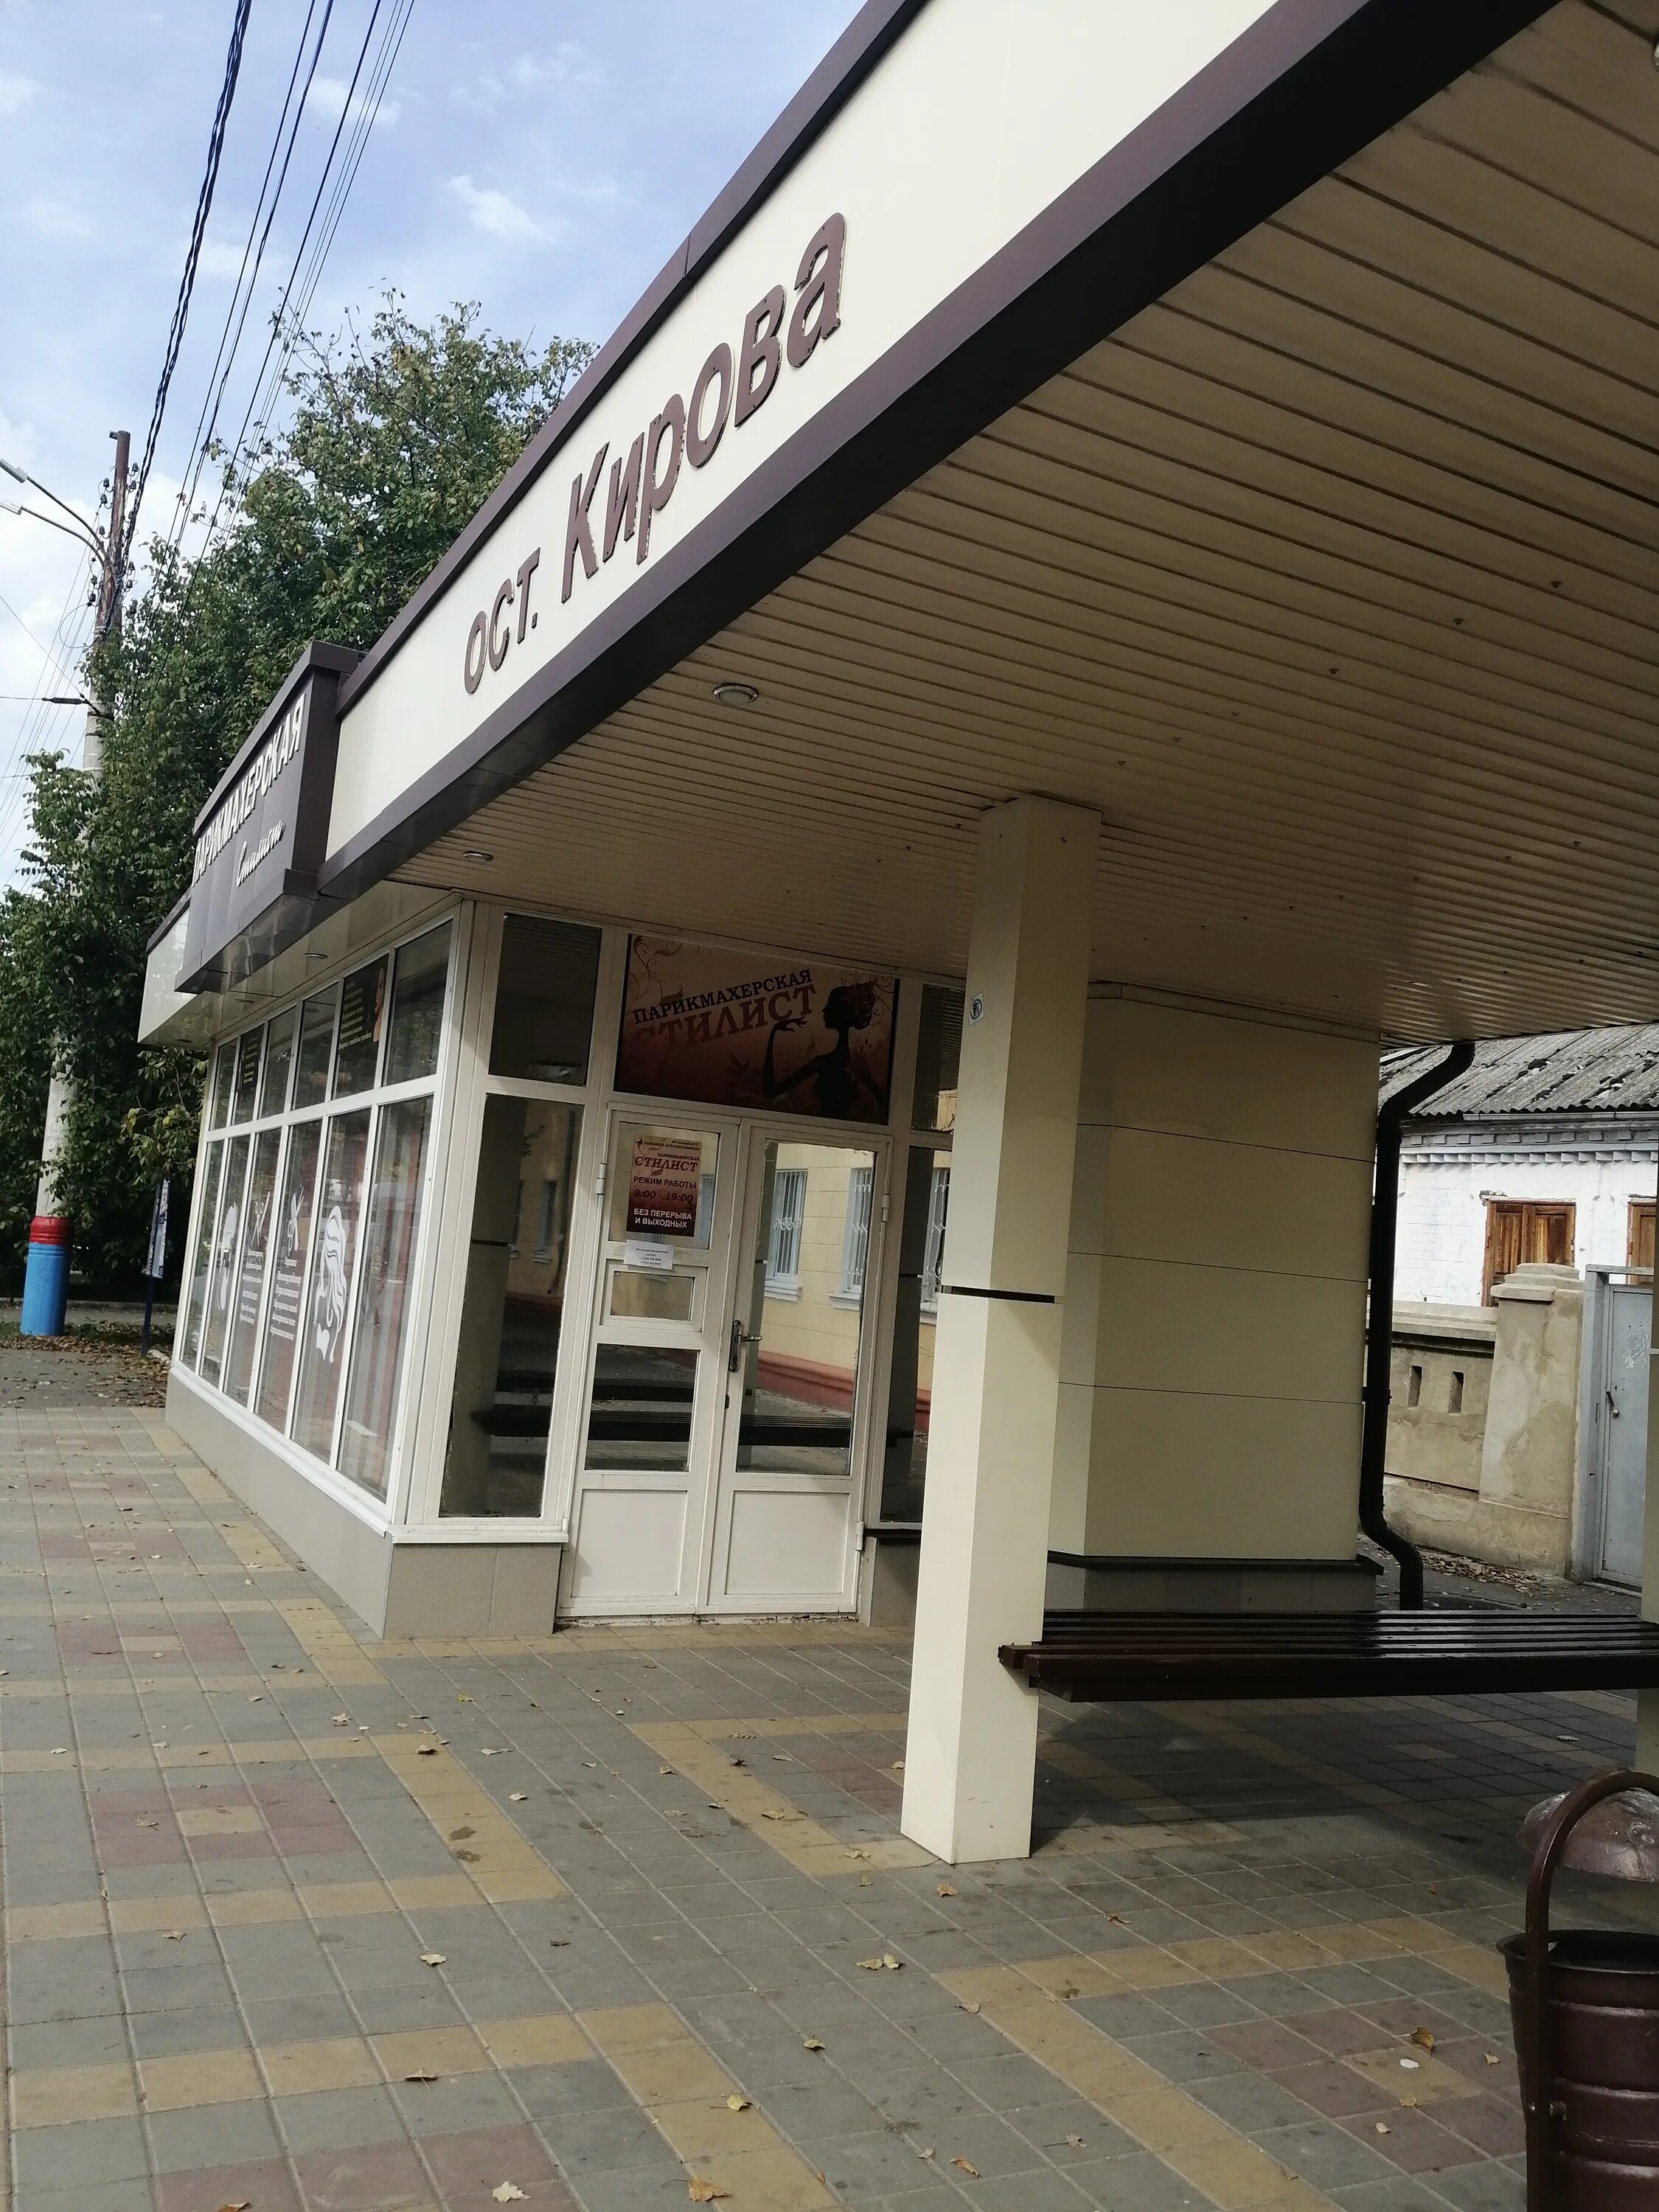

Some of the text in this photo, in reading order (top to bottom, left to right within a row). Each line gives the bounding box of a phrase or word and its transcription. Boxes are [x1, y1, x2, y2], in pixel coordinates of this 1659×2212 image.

[464, 212, 847, 695] ост. Кирова
[192, 693, 306, 887] ПАРИКМАХЕРСКАЯ
[633, 969, 813, 1024] ПАРИКМАХЕРСКАЯ
[634, 1156, 698, 1172] СТИЛИСТ
[633, 1176, 697, 1189] РЕЖИМ РАБОТЫ
[633, 1208, 692, 1220] БЕЗ ПЕРЕРЫВА
[642, 1219, 687, 1228] ВЫХОДНЫХ
